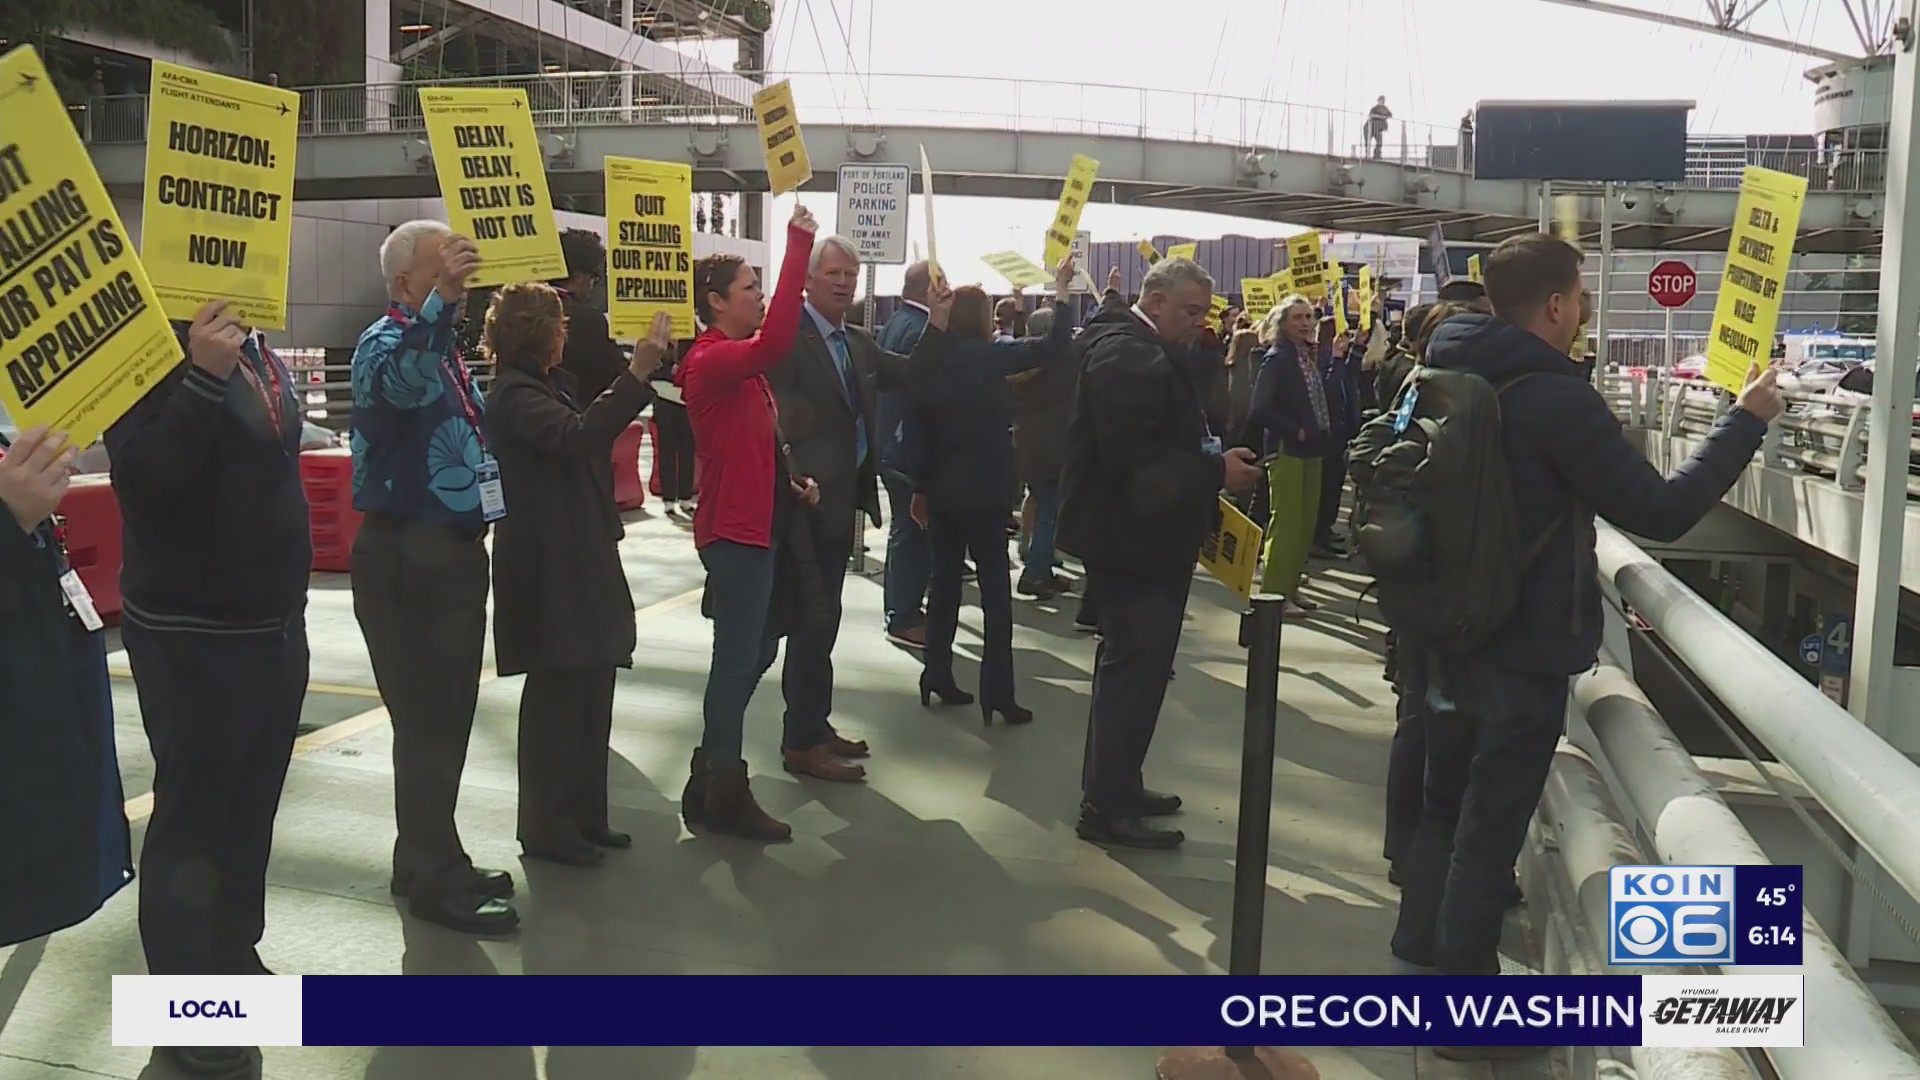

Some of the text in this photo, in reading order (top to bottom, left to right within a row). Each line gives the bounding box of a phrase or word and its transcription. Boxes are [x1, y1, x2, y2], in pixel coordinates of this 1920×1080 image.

[160, 87, 241, 111] FLIGHT ATTENDANTS
[168, 120, 276, 169] HORIZON:
[453, 125, 514, 149] DELAY,
[460, 155, 521, 179] DELAY,
[843, 171, 905, 180] PORT OF PORTLAND
[158, 174, 281, 221] CONTRACT
[459, 183, 535, 210] DELAY IS
[853, 182, 893, 194] POLICE
[634, 193, 666, 217] QUIT
[849, 198, 896, 210] PARKING
[472, 214, 538, 240] NOT OK
[619, 220, 681, 244] STALLING
[857, 214, 886, 226] ONLY
[852, 230, 892, 239] TOW AWAY
[860, 240, 881, 249] ZONE
[188, 234, 247, 269] NOW
[612, 248, 689, 272] OUR PAY IS
[0, 219, 123, 350] UR PAY IS
[616, 277, 687, 298] APPALLING
[1651, 275, 1694, 293] STOP
[1734, 298, 1757, 324] WAGE
[5, 270, 143, 402] APPALLING
[1719, 323, 1760, 358] INEQUALITY
[1827, 622, 1850, 654] 4
